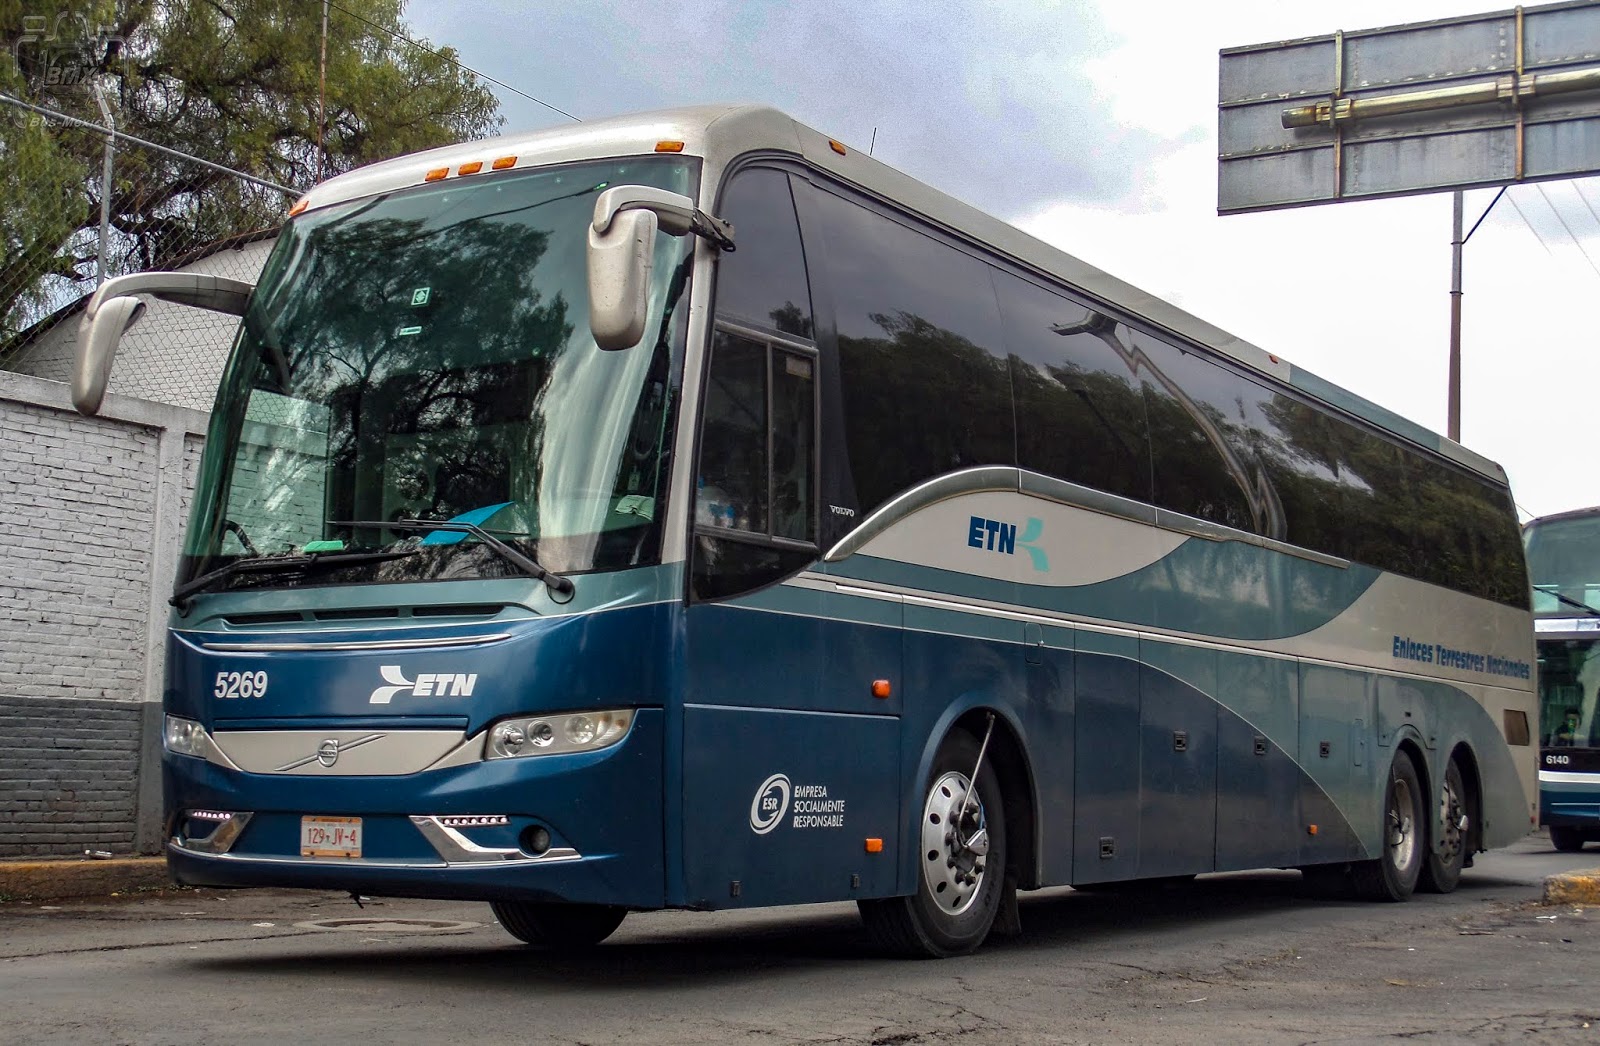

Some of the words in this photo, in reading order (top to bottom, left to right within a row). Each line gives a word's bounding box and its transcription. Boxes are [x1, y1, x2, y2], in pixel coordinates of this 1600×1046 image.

[829, 505, 855, 517] VOLVO
[968, 515, 1017, 555] ETN
[1393, 635, 1433, 662] Enlaces
[1436, 644, 1485, 672] Terrestres
[1486, 654, 1530, 680] Nacionales
[214, 670, 268, 699] 5269
[412, 673, 478, 697] ETN
[1546, 755, 1569, 765] 6140
[794, 785, 828, 798] EMPRESA
[762, 797, 778, 810] ESR
[793, 800, 845, 813] SOCIALMENTE
[793, 815, 844, 828] RESPONSABLE
